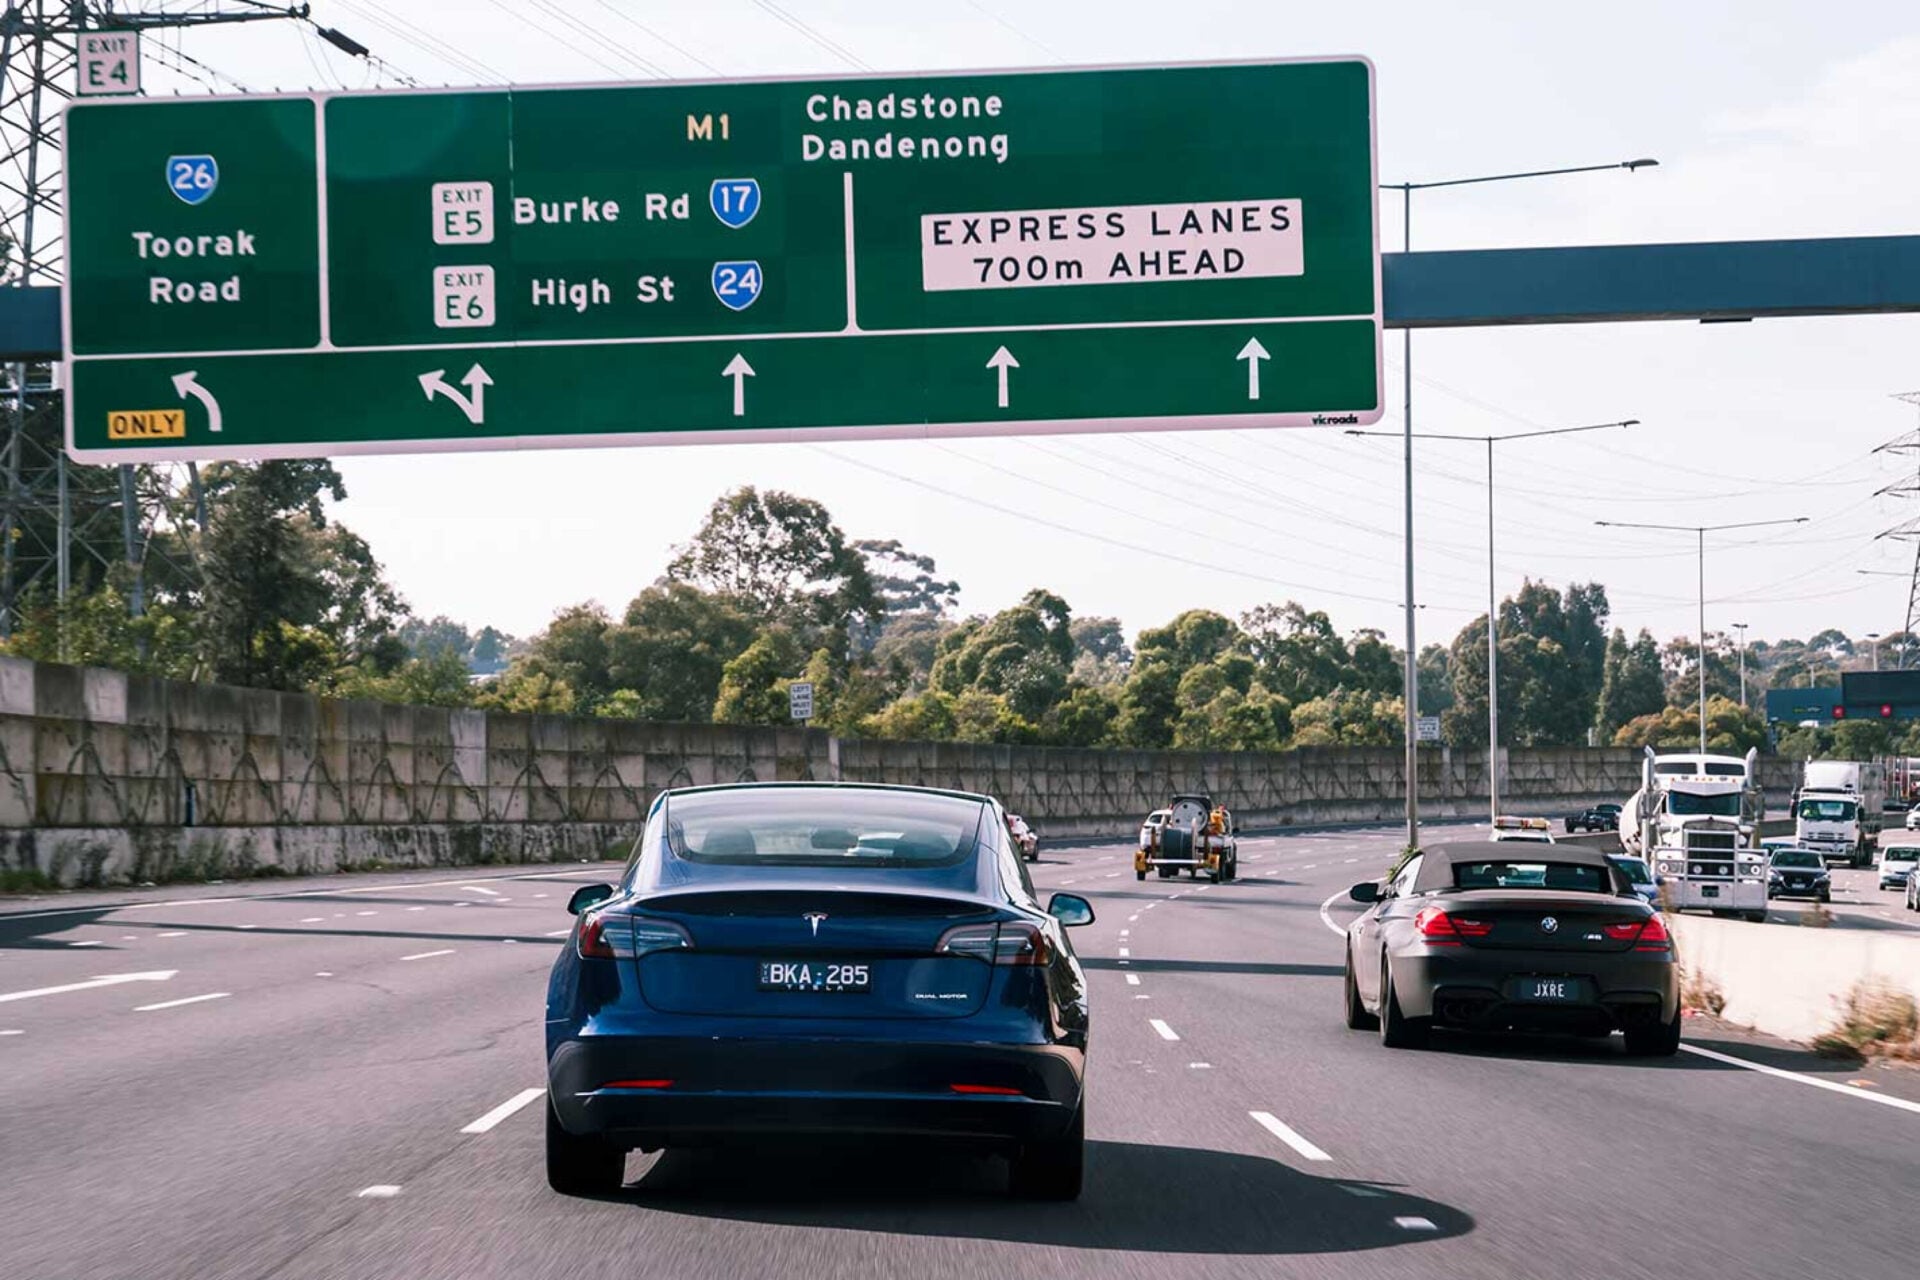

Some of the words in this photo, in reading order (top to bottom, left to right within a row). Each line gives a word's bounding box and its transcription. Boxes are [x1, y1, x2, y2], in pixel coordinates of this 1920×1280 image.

[87, 38, 129, 53] EXIT
[88, 59, 129, 86] E4
[806, 93, 1003, 122] Chadstone
[686, 113, 730, 141] M1
[802, 133, 1008, 164] Dandenong
[173, 162, 214, 190] 26
[442, 188, 483, 204] EXIT
[513, 196, 621, 225] Burke
[645, 192, 691, 220] Rd
[720, 185, 752, 214] 17
[444, 210, 483, 237] E5
[933, 212, 1126, 246] EXPRESS
[1151, 205, 1291, 236] LANES
[131, 229, 257, 258] Toorak
[973, 254, 1084, 283] 700m
[1108, 247, 1245, 278] AHEAD
[149, 275, 241, 304] Road
[443, 272, 485, 288] EXIT
[531, 278, 611, 313] High
[637, 275, 676, 303] St
[718, 268, 759, 297] 24
[445, 294, 484, 321] E6
[112, 413, 179, 435] ONLY
[770, 963, 812, 984] BKA
[825, 965, 869, 985] 285
[1534, 983, 1565, 998] JXRE
